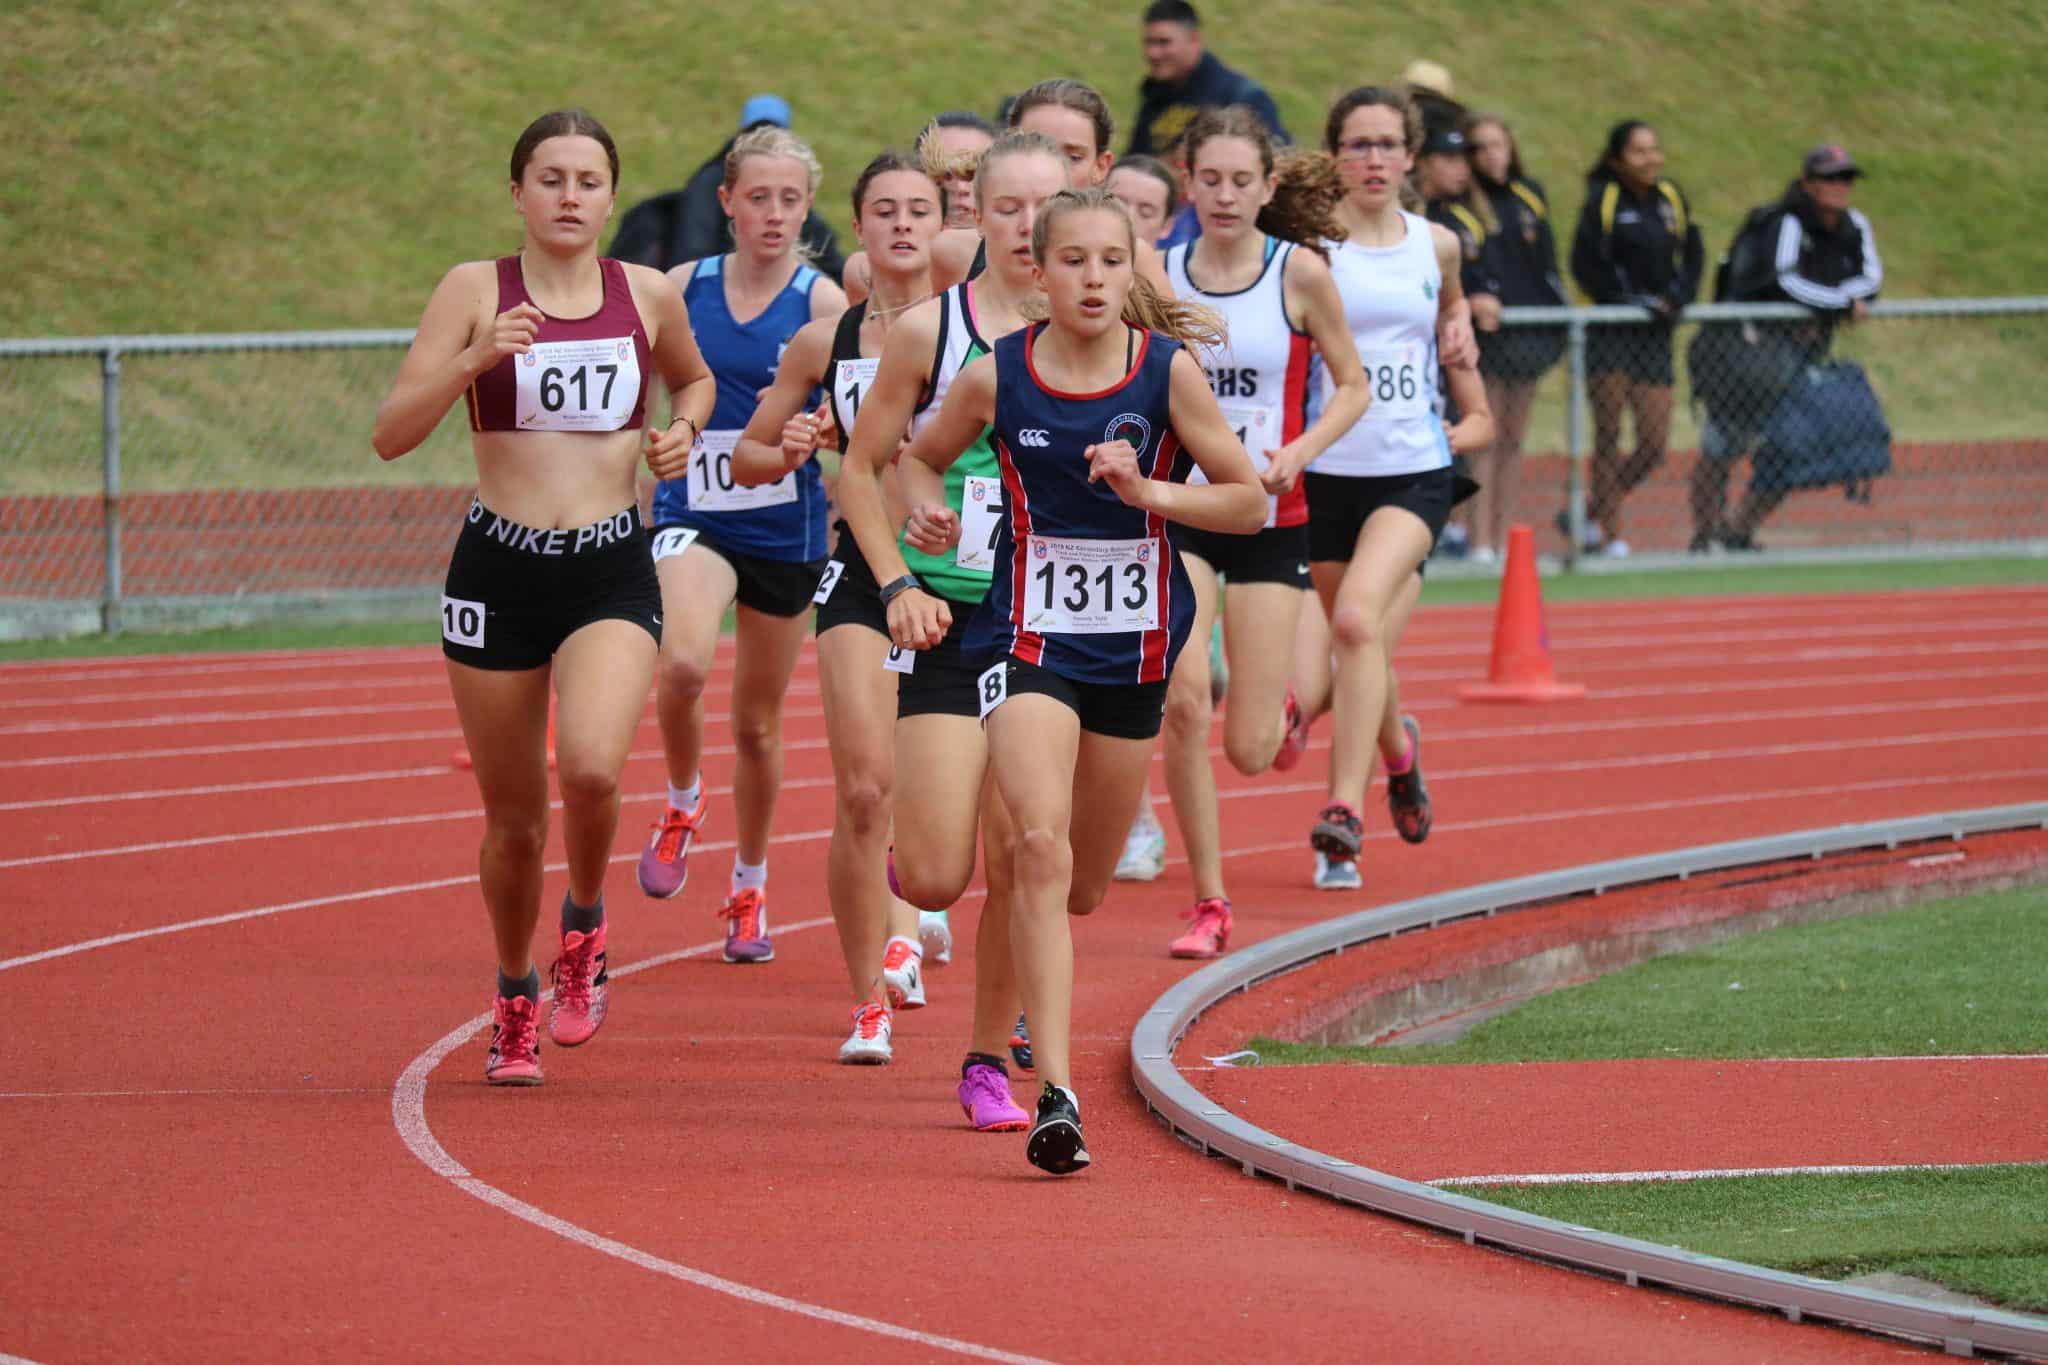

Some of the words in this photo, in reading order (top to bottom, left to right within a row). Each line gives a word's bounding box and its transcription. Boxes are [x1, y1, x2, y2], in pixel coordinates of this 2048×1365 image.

[540, 364, 618, 412] 617
[845, 382, 860, 417] 1
[1362, 364, 1416, 401] 86
[486, 515, 569, 555] NIKE
[574, 510, 633, 554] PRO
[986, 503, 1004, 550] 7
[1036, 560, 1148, 612] 1313
[443, 602, 480, 638] 10
[984, 671, 1002, 703] 8
